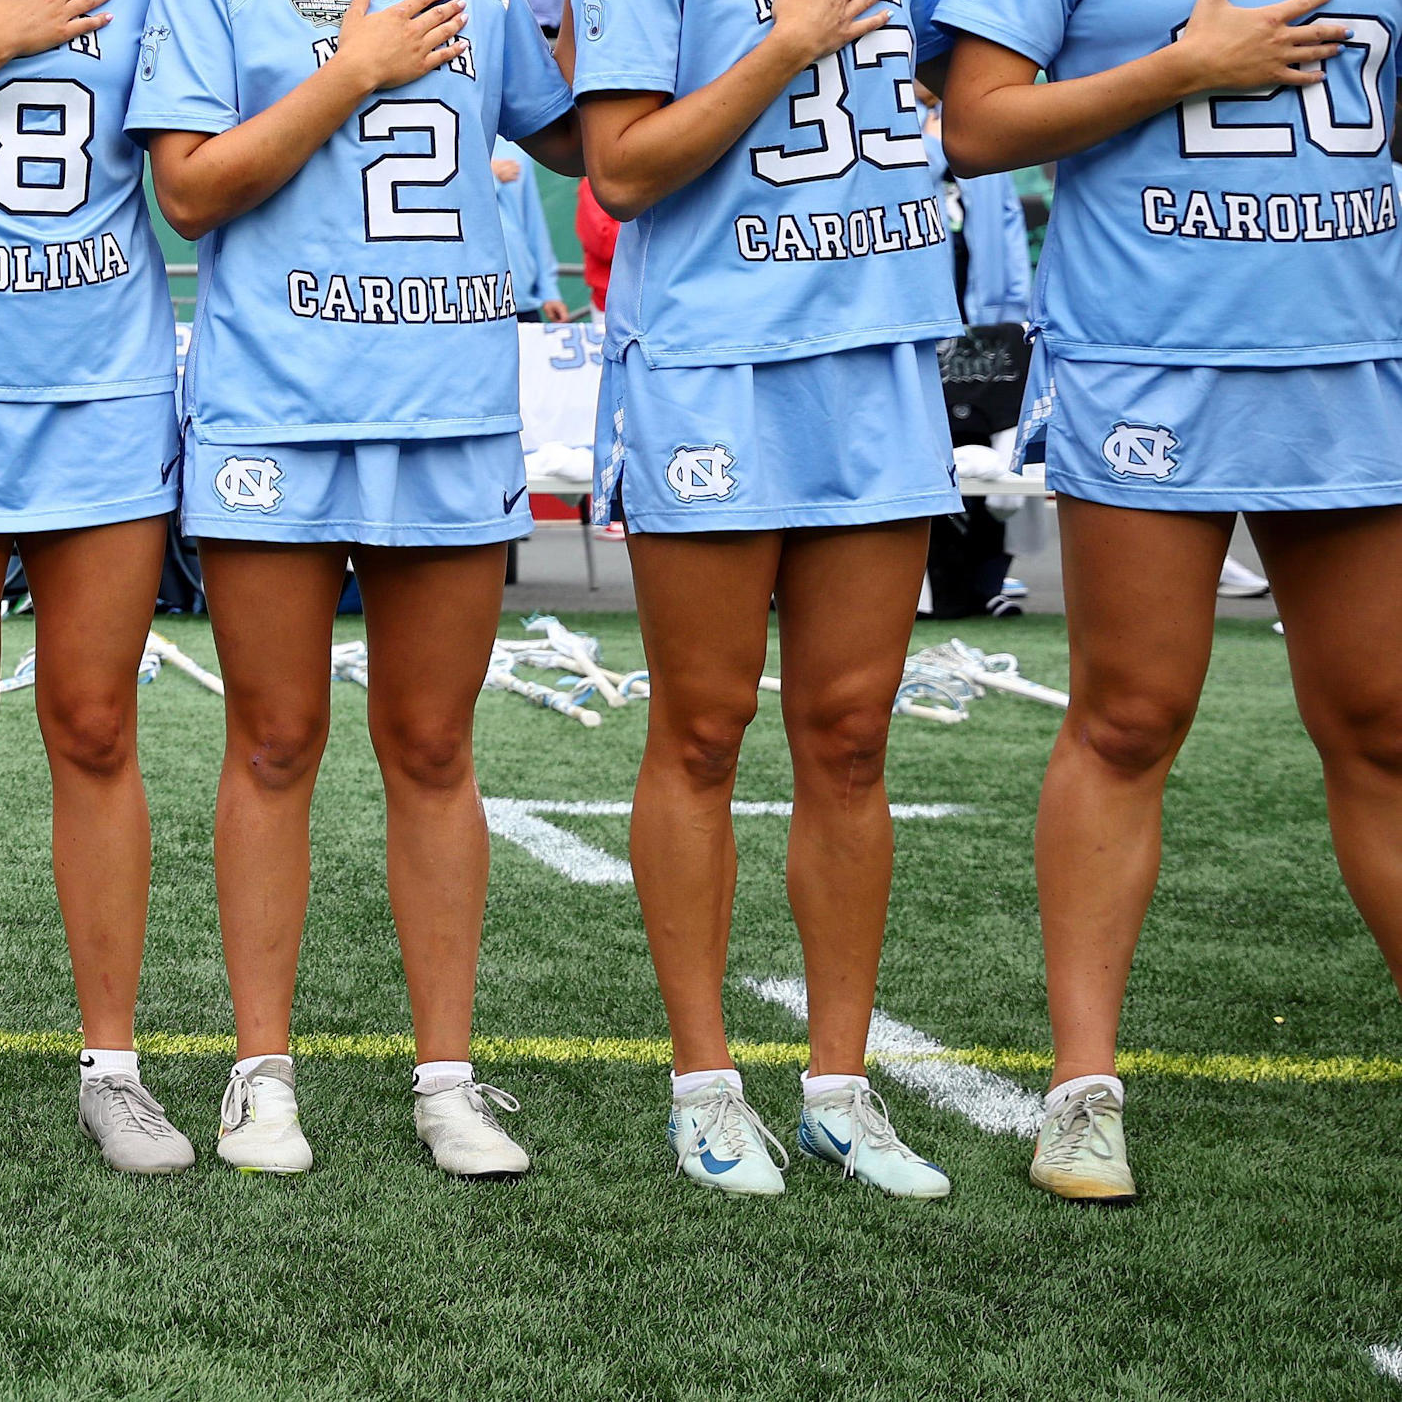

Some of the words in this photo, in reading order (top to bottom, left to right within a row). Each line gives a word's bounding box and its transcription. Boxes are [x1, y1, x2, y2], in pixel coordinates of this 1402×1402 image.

[749, 25, 929, 187] 33
[1171, 12, 1392, 159] 20
[358, 98, 464, 243] 2
[1141, 183, 1397, 241] CAROLINA
[734, 195, 946, 262] CAROLIN
[287, 269, 517, 325] CAROLINA
